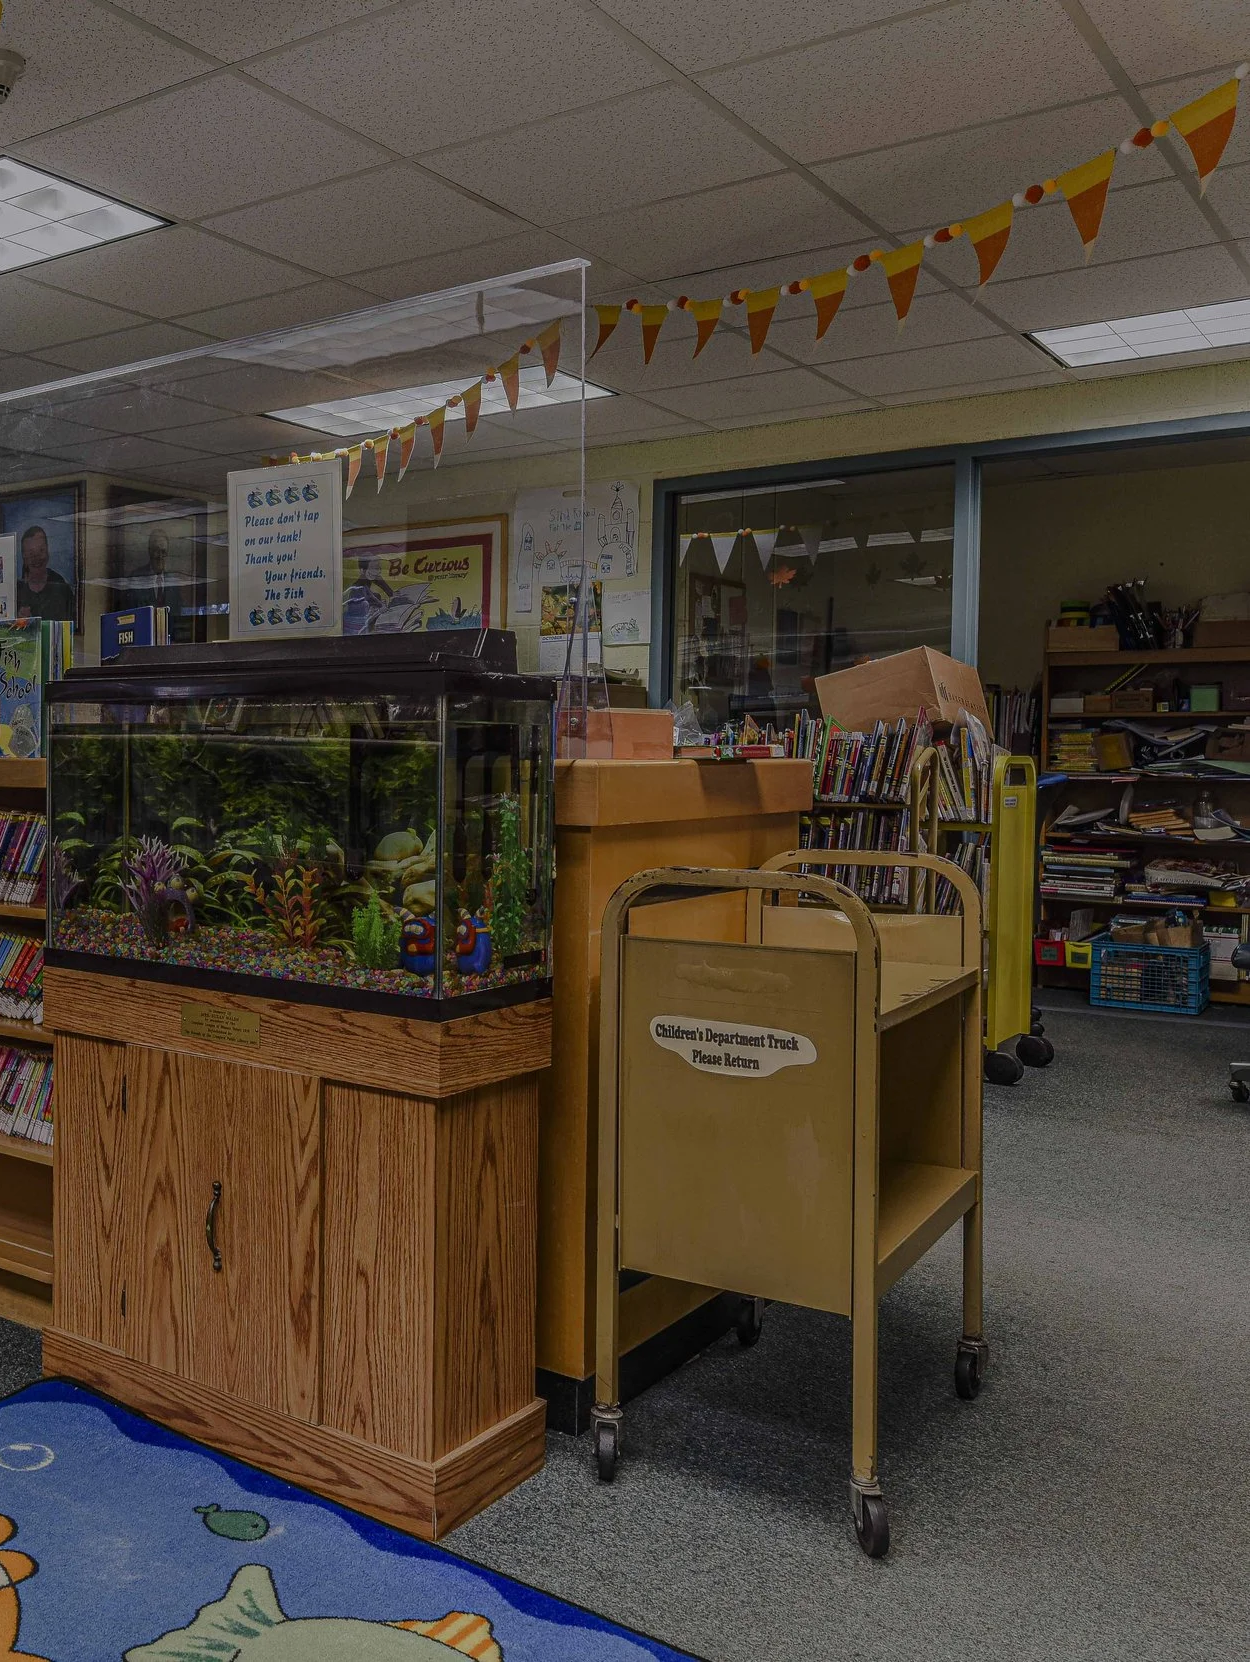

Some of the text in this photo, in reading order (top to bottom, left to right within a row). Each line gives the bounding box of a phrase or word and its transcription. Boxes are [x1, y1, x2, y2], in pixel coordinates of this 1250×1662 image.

[245, 510, 319, 527] Please don't tap
[245, 530, 302, 546] on our tank!
[246, 550, 297, 565] Thank you!
[389, 555, 469, 576] Be Curious
[265, 570, 287, 584] Your
[265, 587, 304, 600] The Fish
[119, 631, 133, 644] FISH
[0, 672, 36, 699] School
[655, 1023, 799, 1051] Children's Department Truck
[692, 1050, 759, 1070] Please Return
